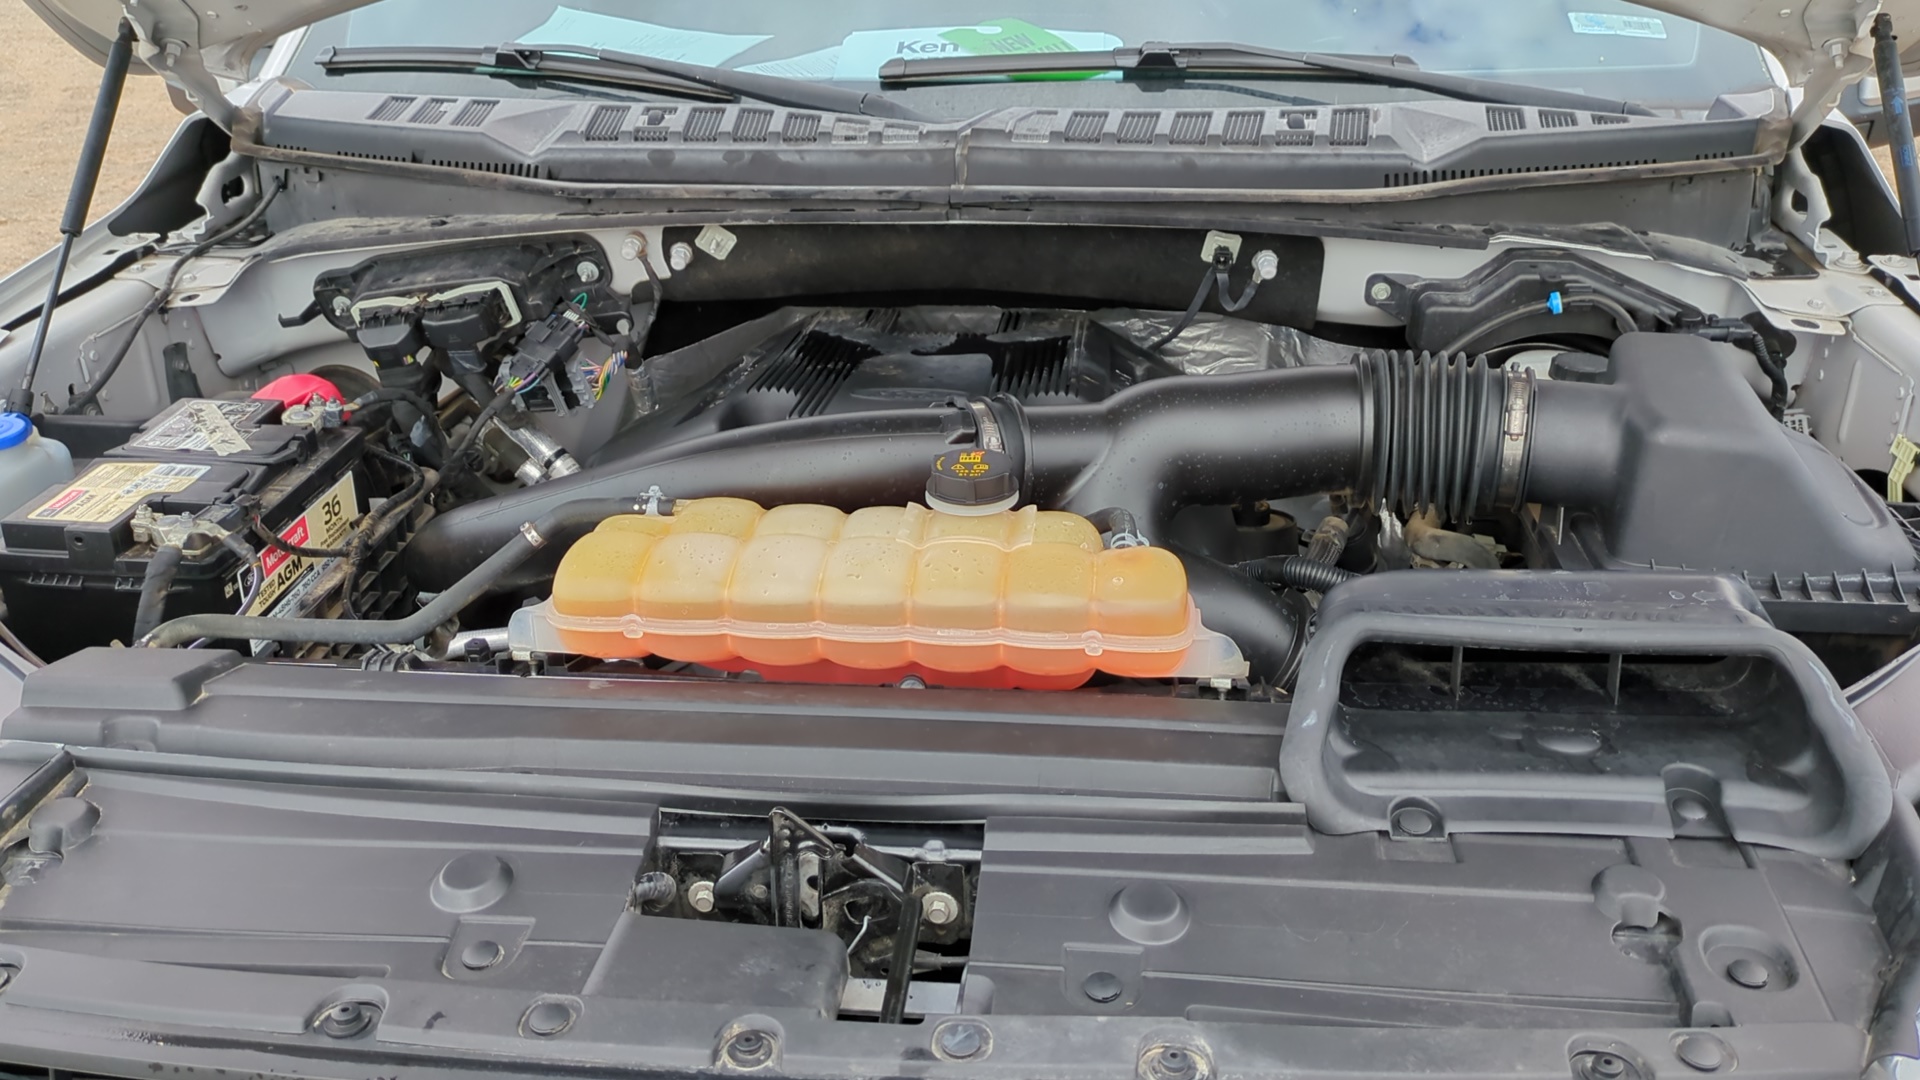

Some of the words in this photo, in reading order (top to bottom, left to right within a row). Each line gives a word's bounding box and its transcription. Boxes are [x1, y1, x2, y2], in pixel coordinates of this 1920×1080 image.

[896, 40, 960, 54] Ken
[989, 32, 1036, 53] NEW
[322, 494, 342, 525] 36
[326, 515, 343, 534] MONTH
[277, 555, 303, 591] AGM
[258, 579, 276, 600] TESTED
